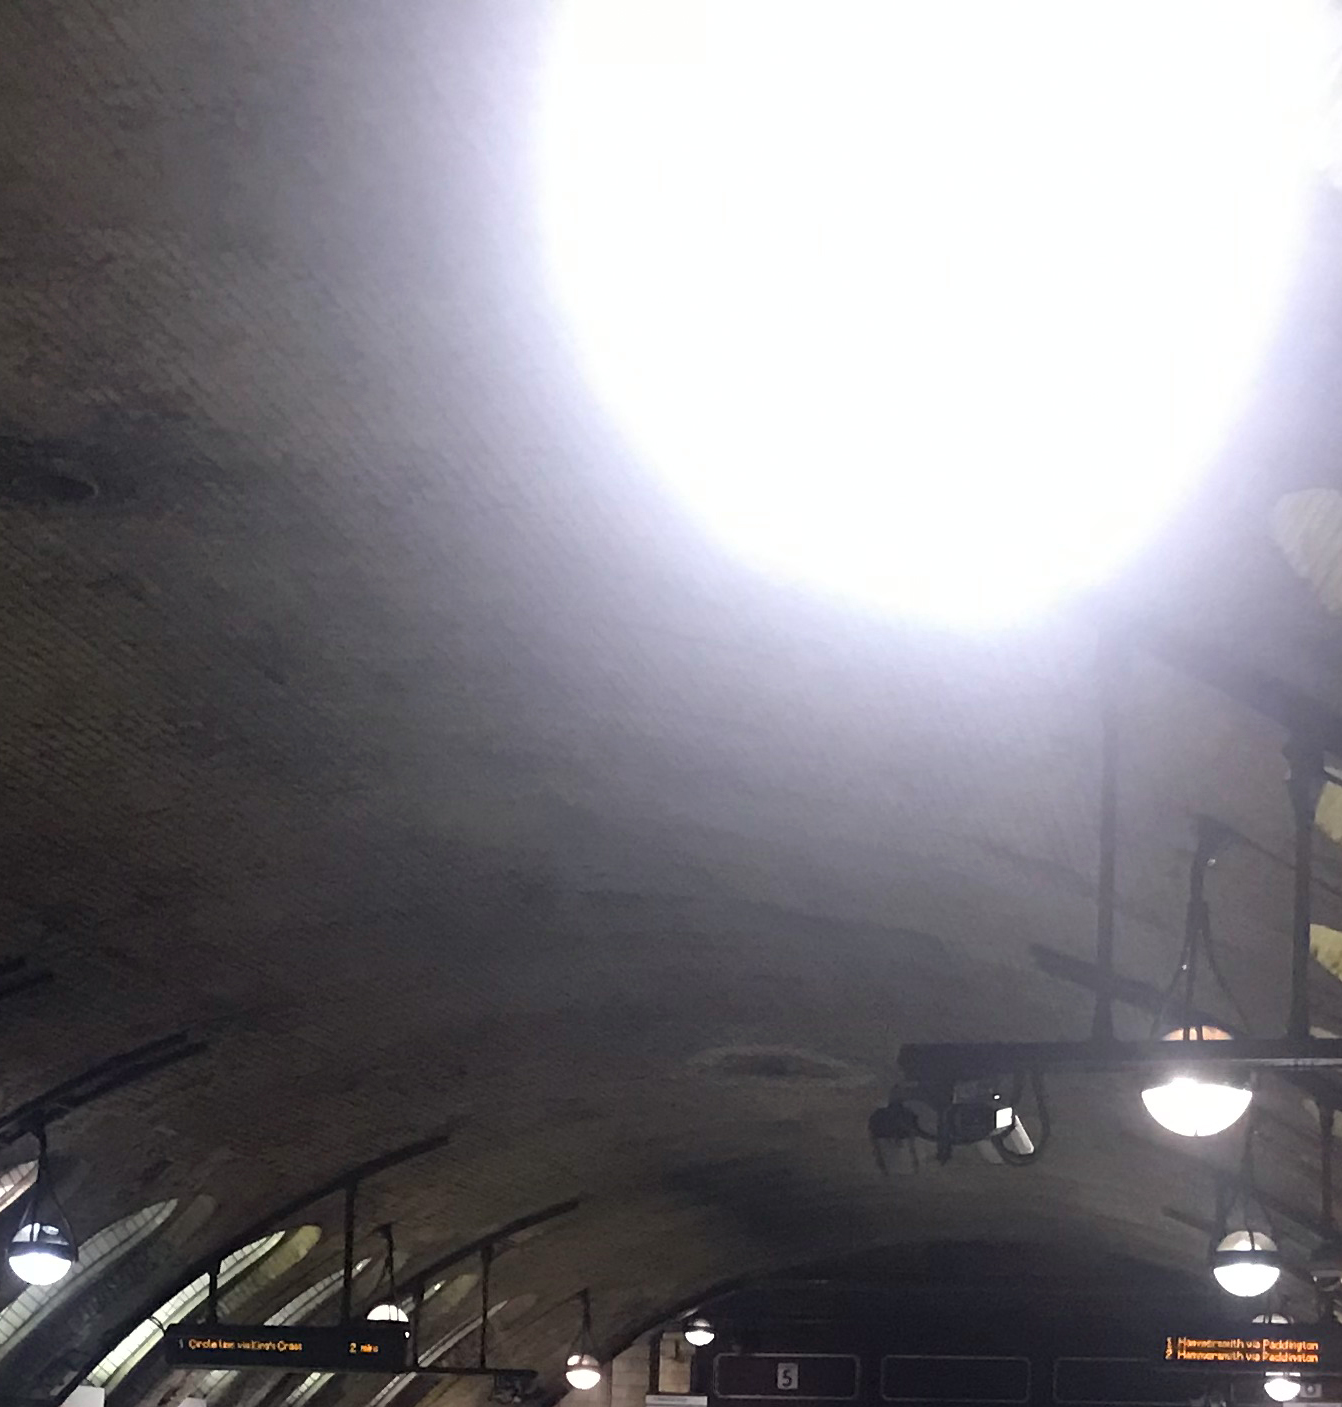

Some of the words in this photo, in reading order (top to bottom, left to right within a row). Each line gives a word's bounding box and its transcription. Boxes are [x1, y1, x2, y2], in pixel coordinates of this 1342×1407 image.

[188, 1338, 218, 1350] Circle
[237, 1341, 250, 1349] via
[276, 1341, 303, 1352] Cross
[1177, 1336, 1244, 1349] Hammersmith
[1246, 1340, 1260, 1349] via
[1262, 1338, 1319, 1352] Paddington
[1245, 1352, 1260, 1361] via
[782, 1369, 792, 1387] 5
